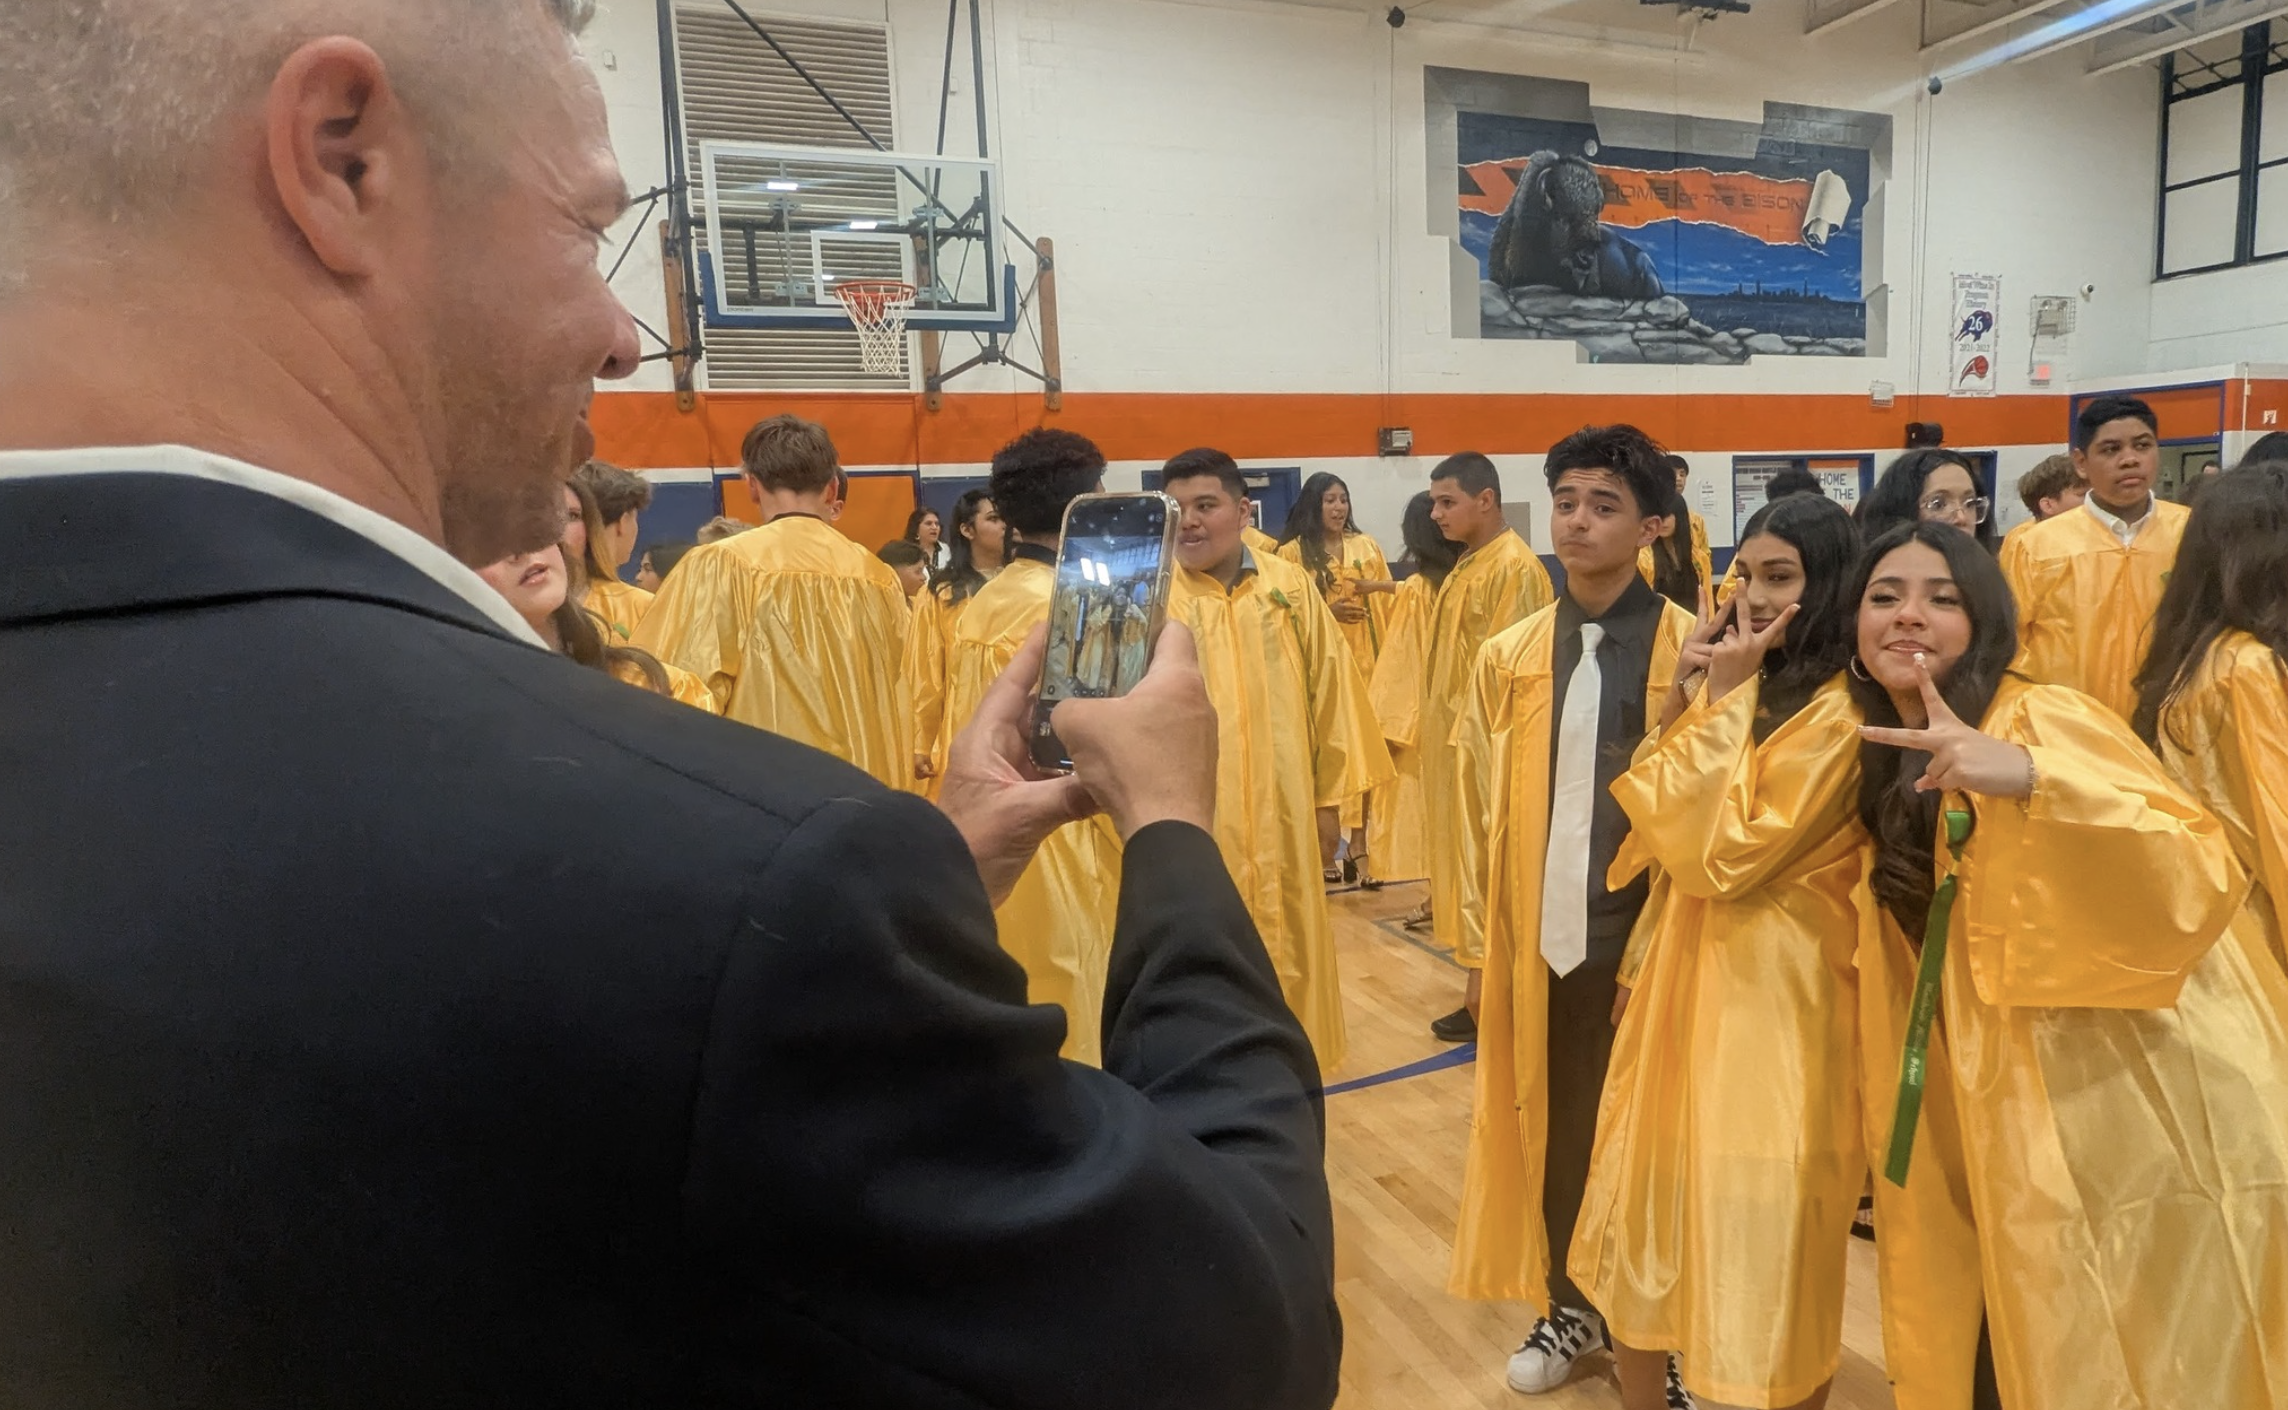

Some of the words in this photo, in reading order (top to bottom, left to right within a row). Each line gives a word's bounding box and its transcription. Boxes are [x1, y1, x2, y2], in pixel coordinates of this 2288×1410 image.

[1603, 183, 1669, 201] HOME
[1703, 193, 1735, 207] THE
[1741, 192, 1804, 212] BISON
[1968, 315, 1984, 331] 26
[1819, 472, 1846, 486] HOME
[1833, 488, 1854, 500] THE
